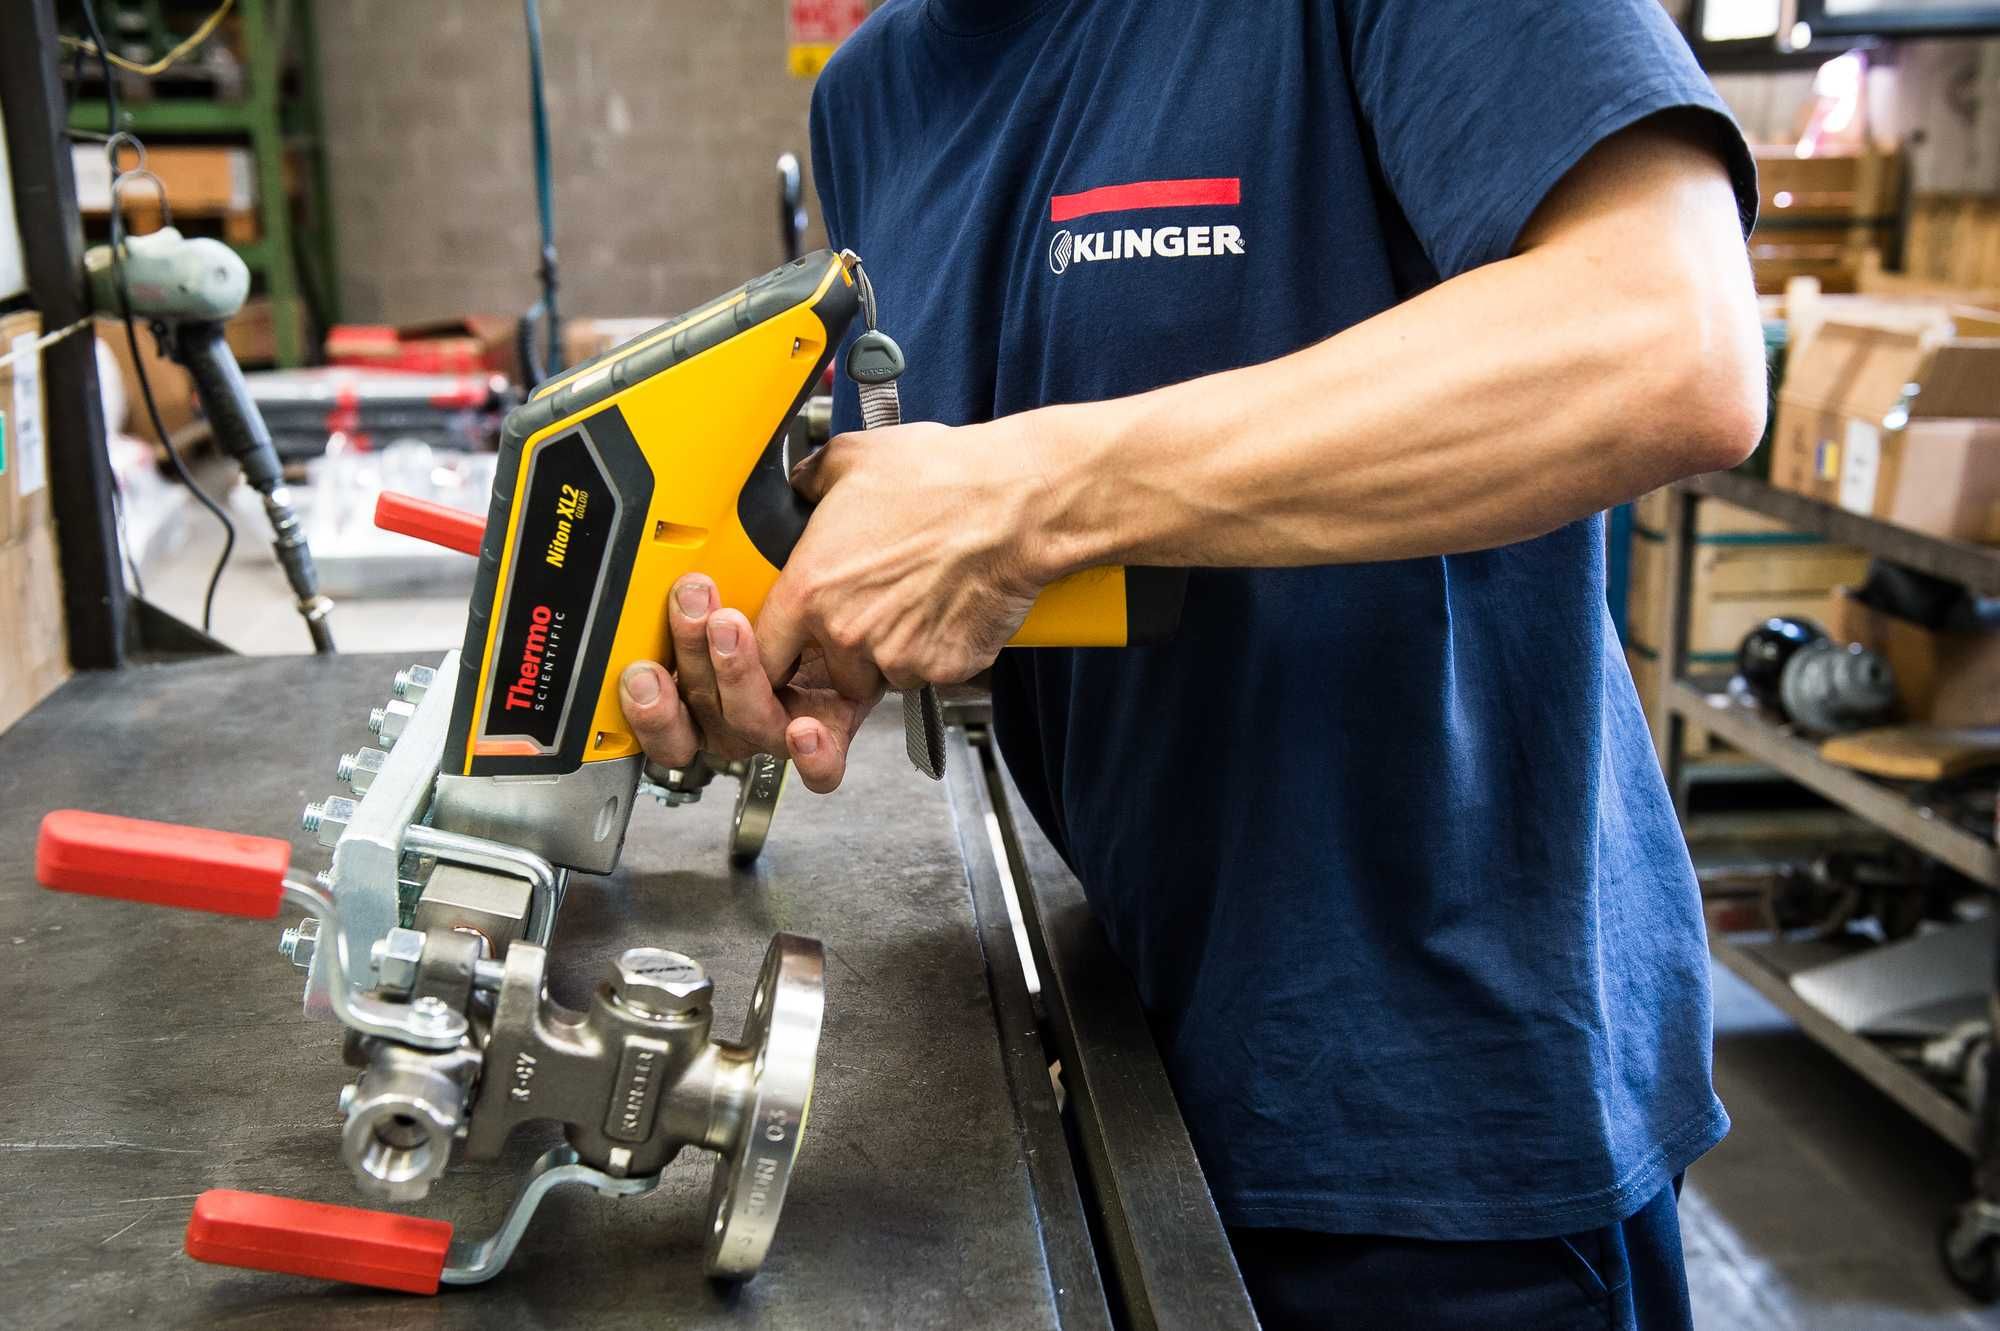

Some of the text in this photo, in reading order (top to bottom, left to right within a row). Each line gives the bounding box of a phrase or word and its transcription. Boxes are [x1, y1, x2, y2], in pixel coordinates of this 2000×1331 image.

[546, 484, 580, 568] Niton XL2
[505, 605, 552, 711] Thermo
[534, 611, 566, 711] SCIENTIFIC
